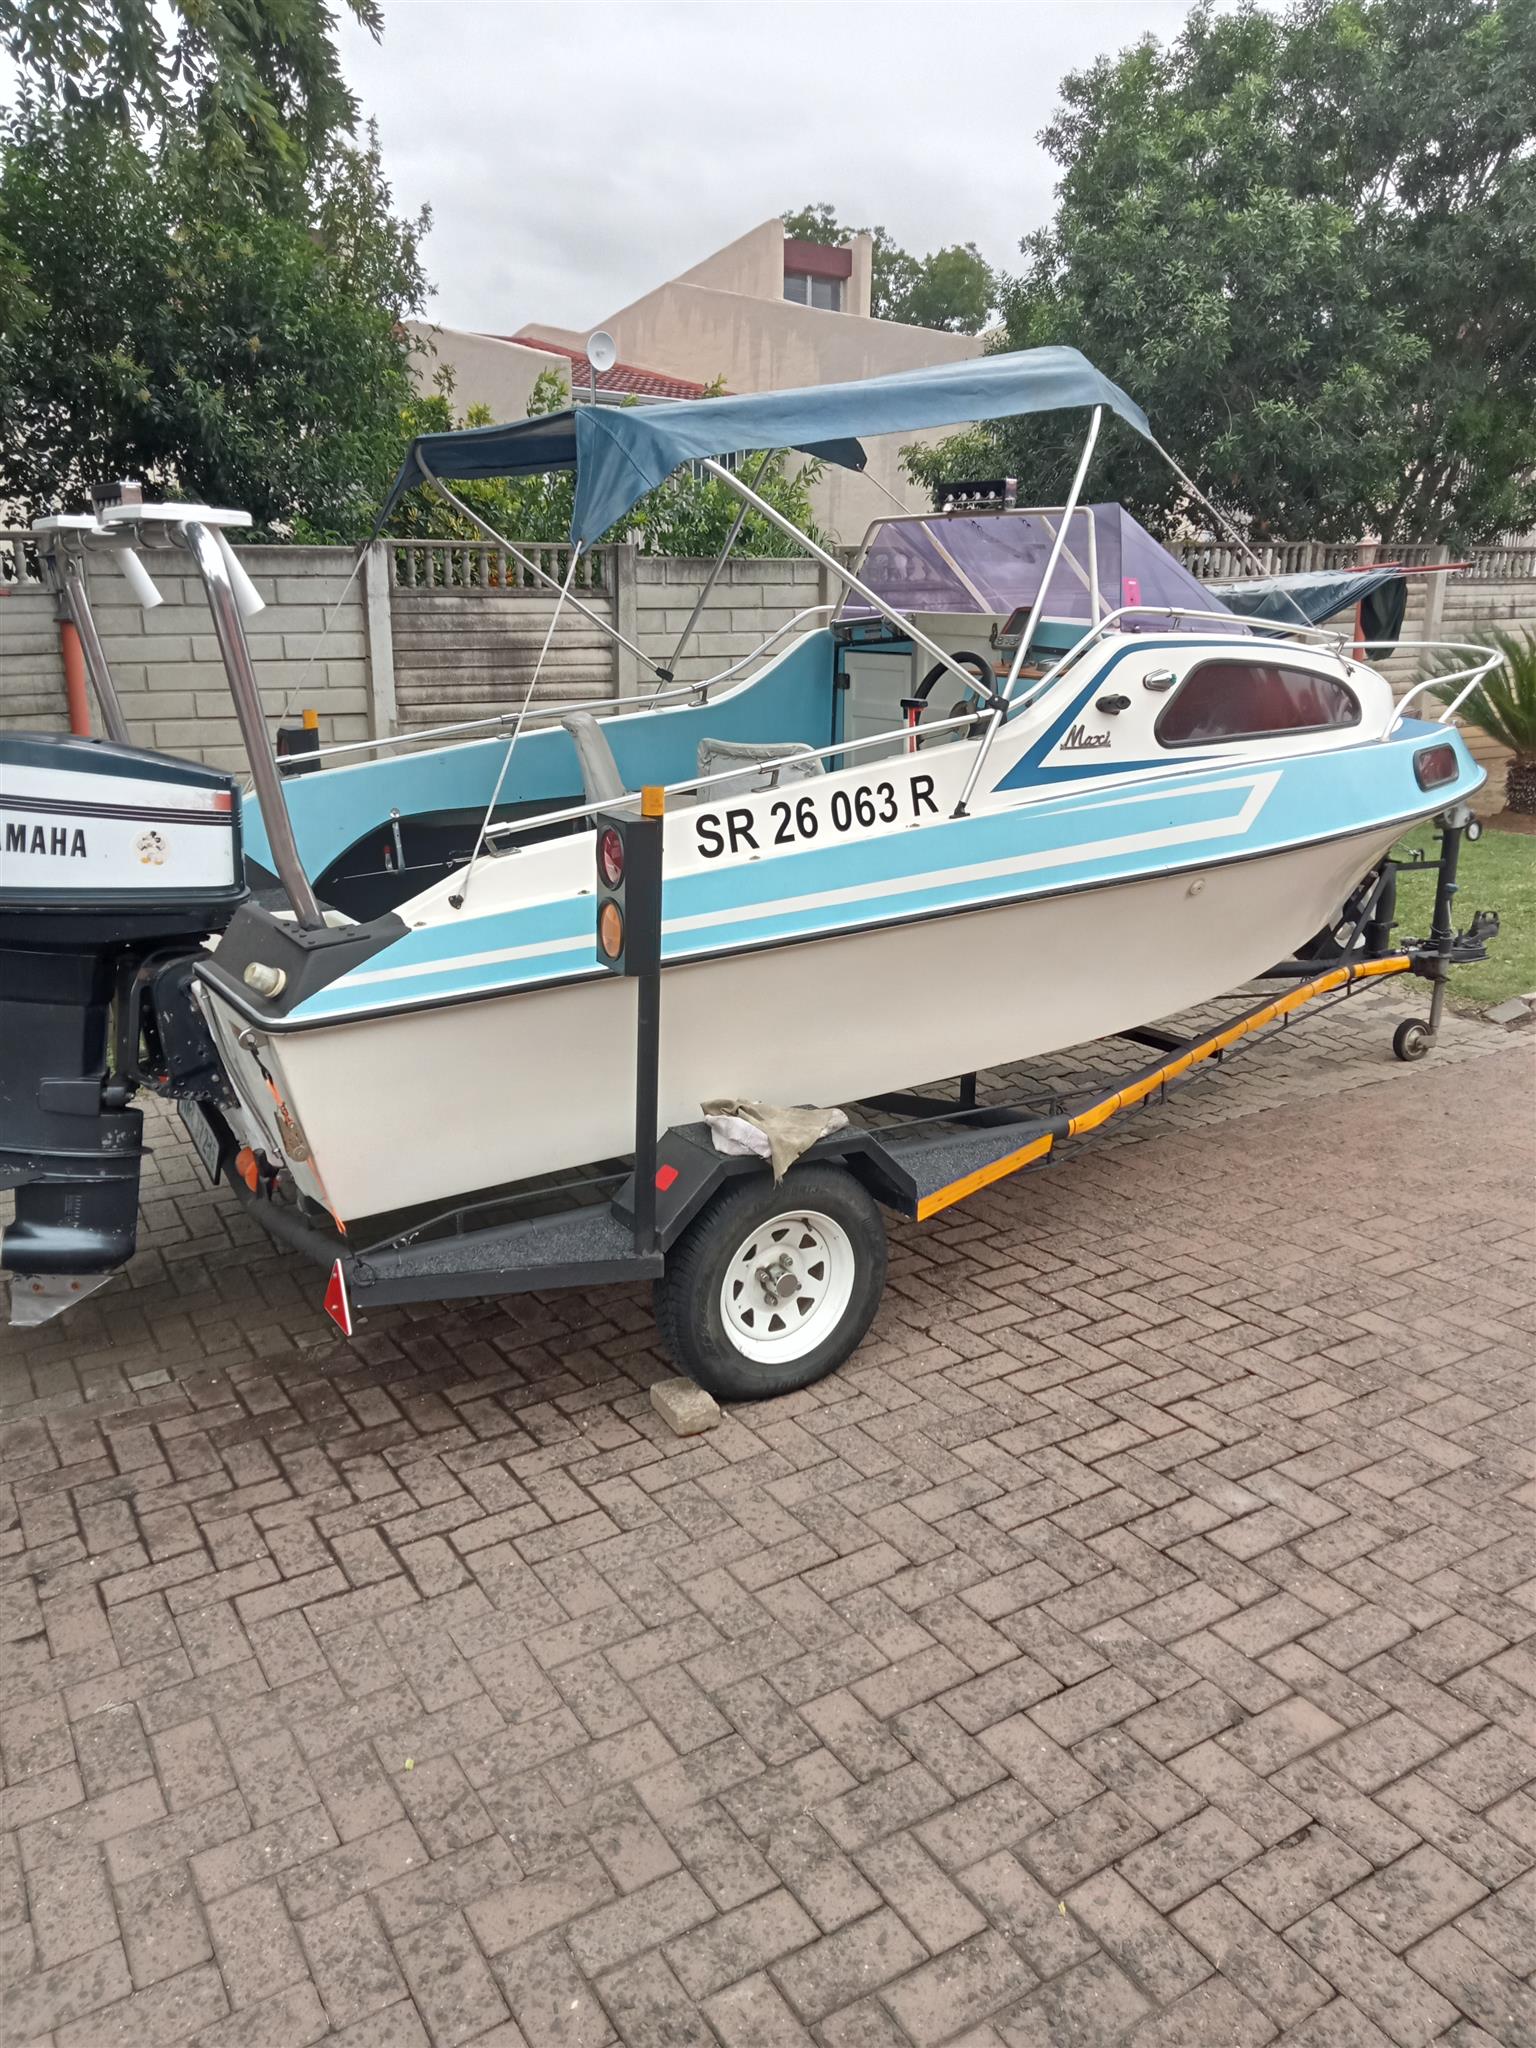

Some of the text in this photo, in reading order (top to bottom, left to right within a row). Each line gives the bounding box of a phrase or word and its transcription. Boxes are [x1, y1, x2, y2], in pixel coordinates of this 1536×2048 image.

[1060, 724, 1112, 751] Maxi
[695, 774, 939, 859] SR 26 063 R
[0, 823, 87, 858] MAHA
